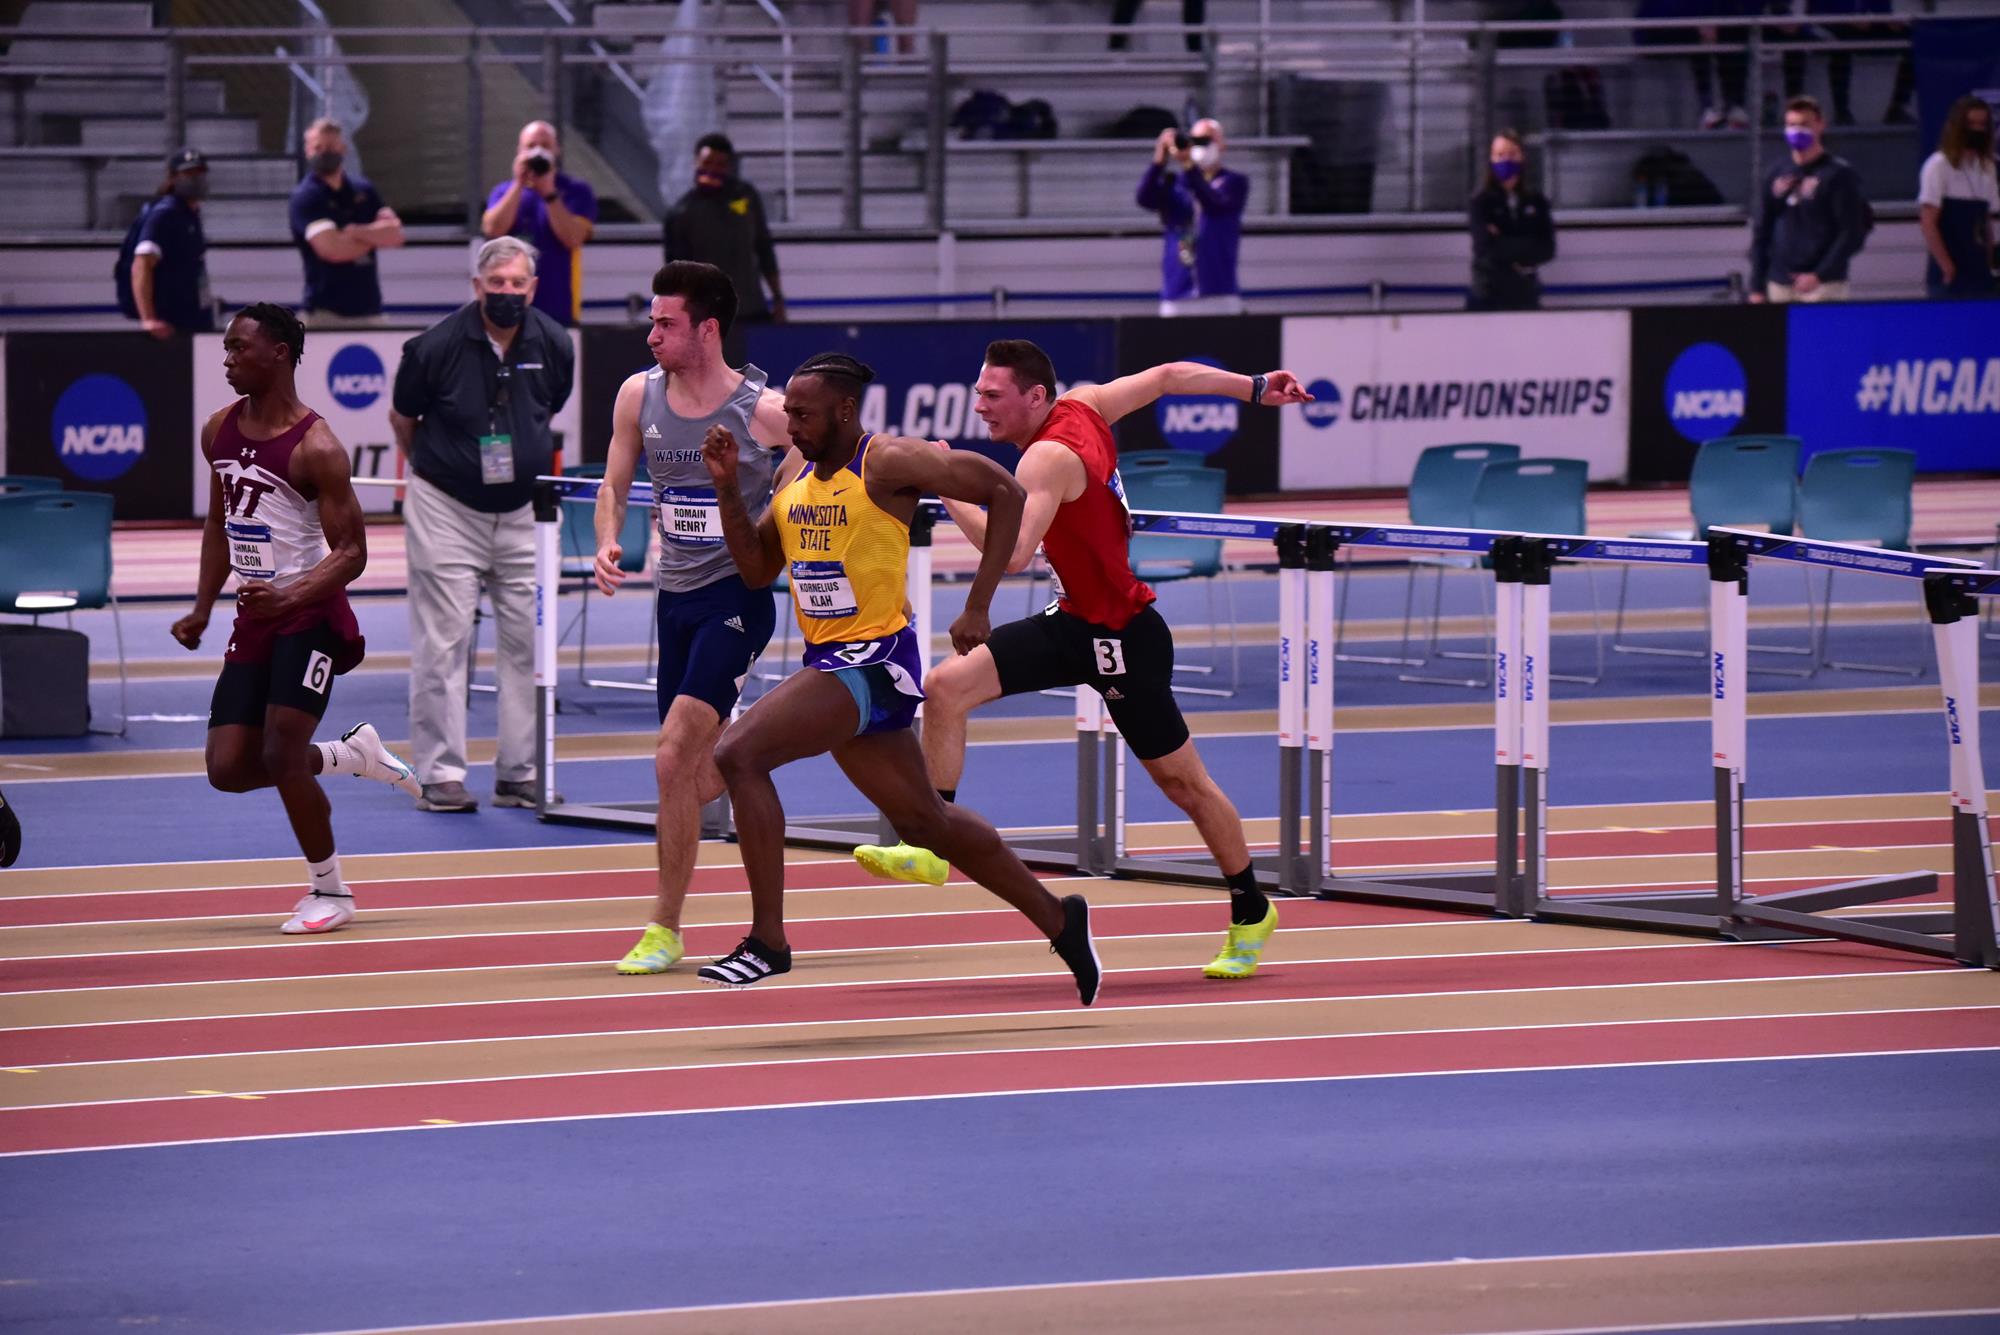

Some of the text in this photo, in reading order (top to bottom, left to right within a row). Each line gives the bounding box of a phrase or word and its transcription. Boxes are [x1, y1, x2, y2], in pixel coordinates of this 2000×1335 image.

[333, 374, 386, 395] NCAA
[1856, 358, 2000, 416] #NCAA
[1350, 379, 1613, 421] CHAMPIONSHIPS
[1672, 390, 1744, 418] NCAA
[1164, 403, 1238, 432] NCAA
[62, 424, 145, 455] NCAA
[655, 450, 705, 462] WASHB
[674, 507, 706, 519] ROMAIN
[674, 520, 707, 533] HENRY
[787, 503, 848, 526] MINNESOTA
[800, 528, 831, 551] STATE
[799, 582, 840, 593] KORNELIUS
[810, 595, 833, 607] KLAH
[1099, 640, 1117, 673] 3
[311, 656, 328, 689] 6
[1714, 652, 1724, 699] NCAA
[1946, 696, 1961, 744] NCAA
